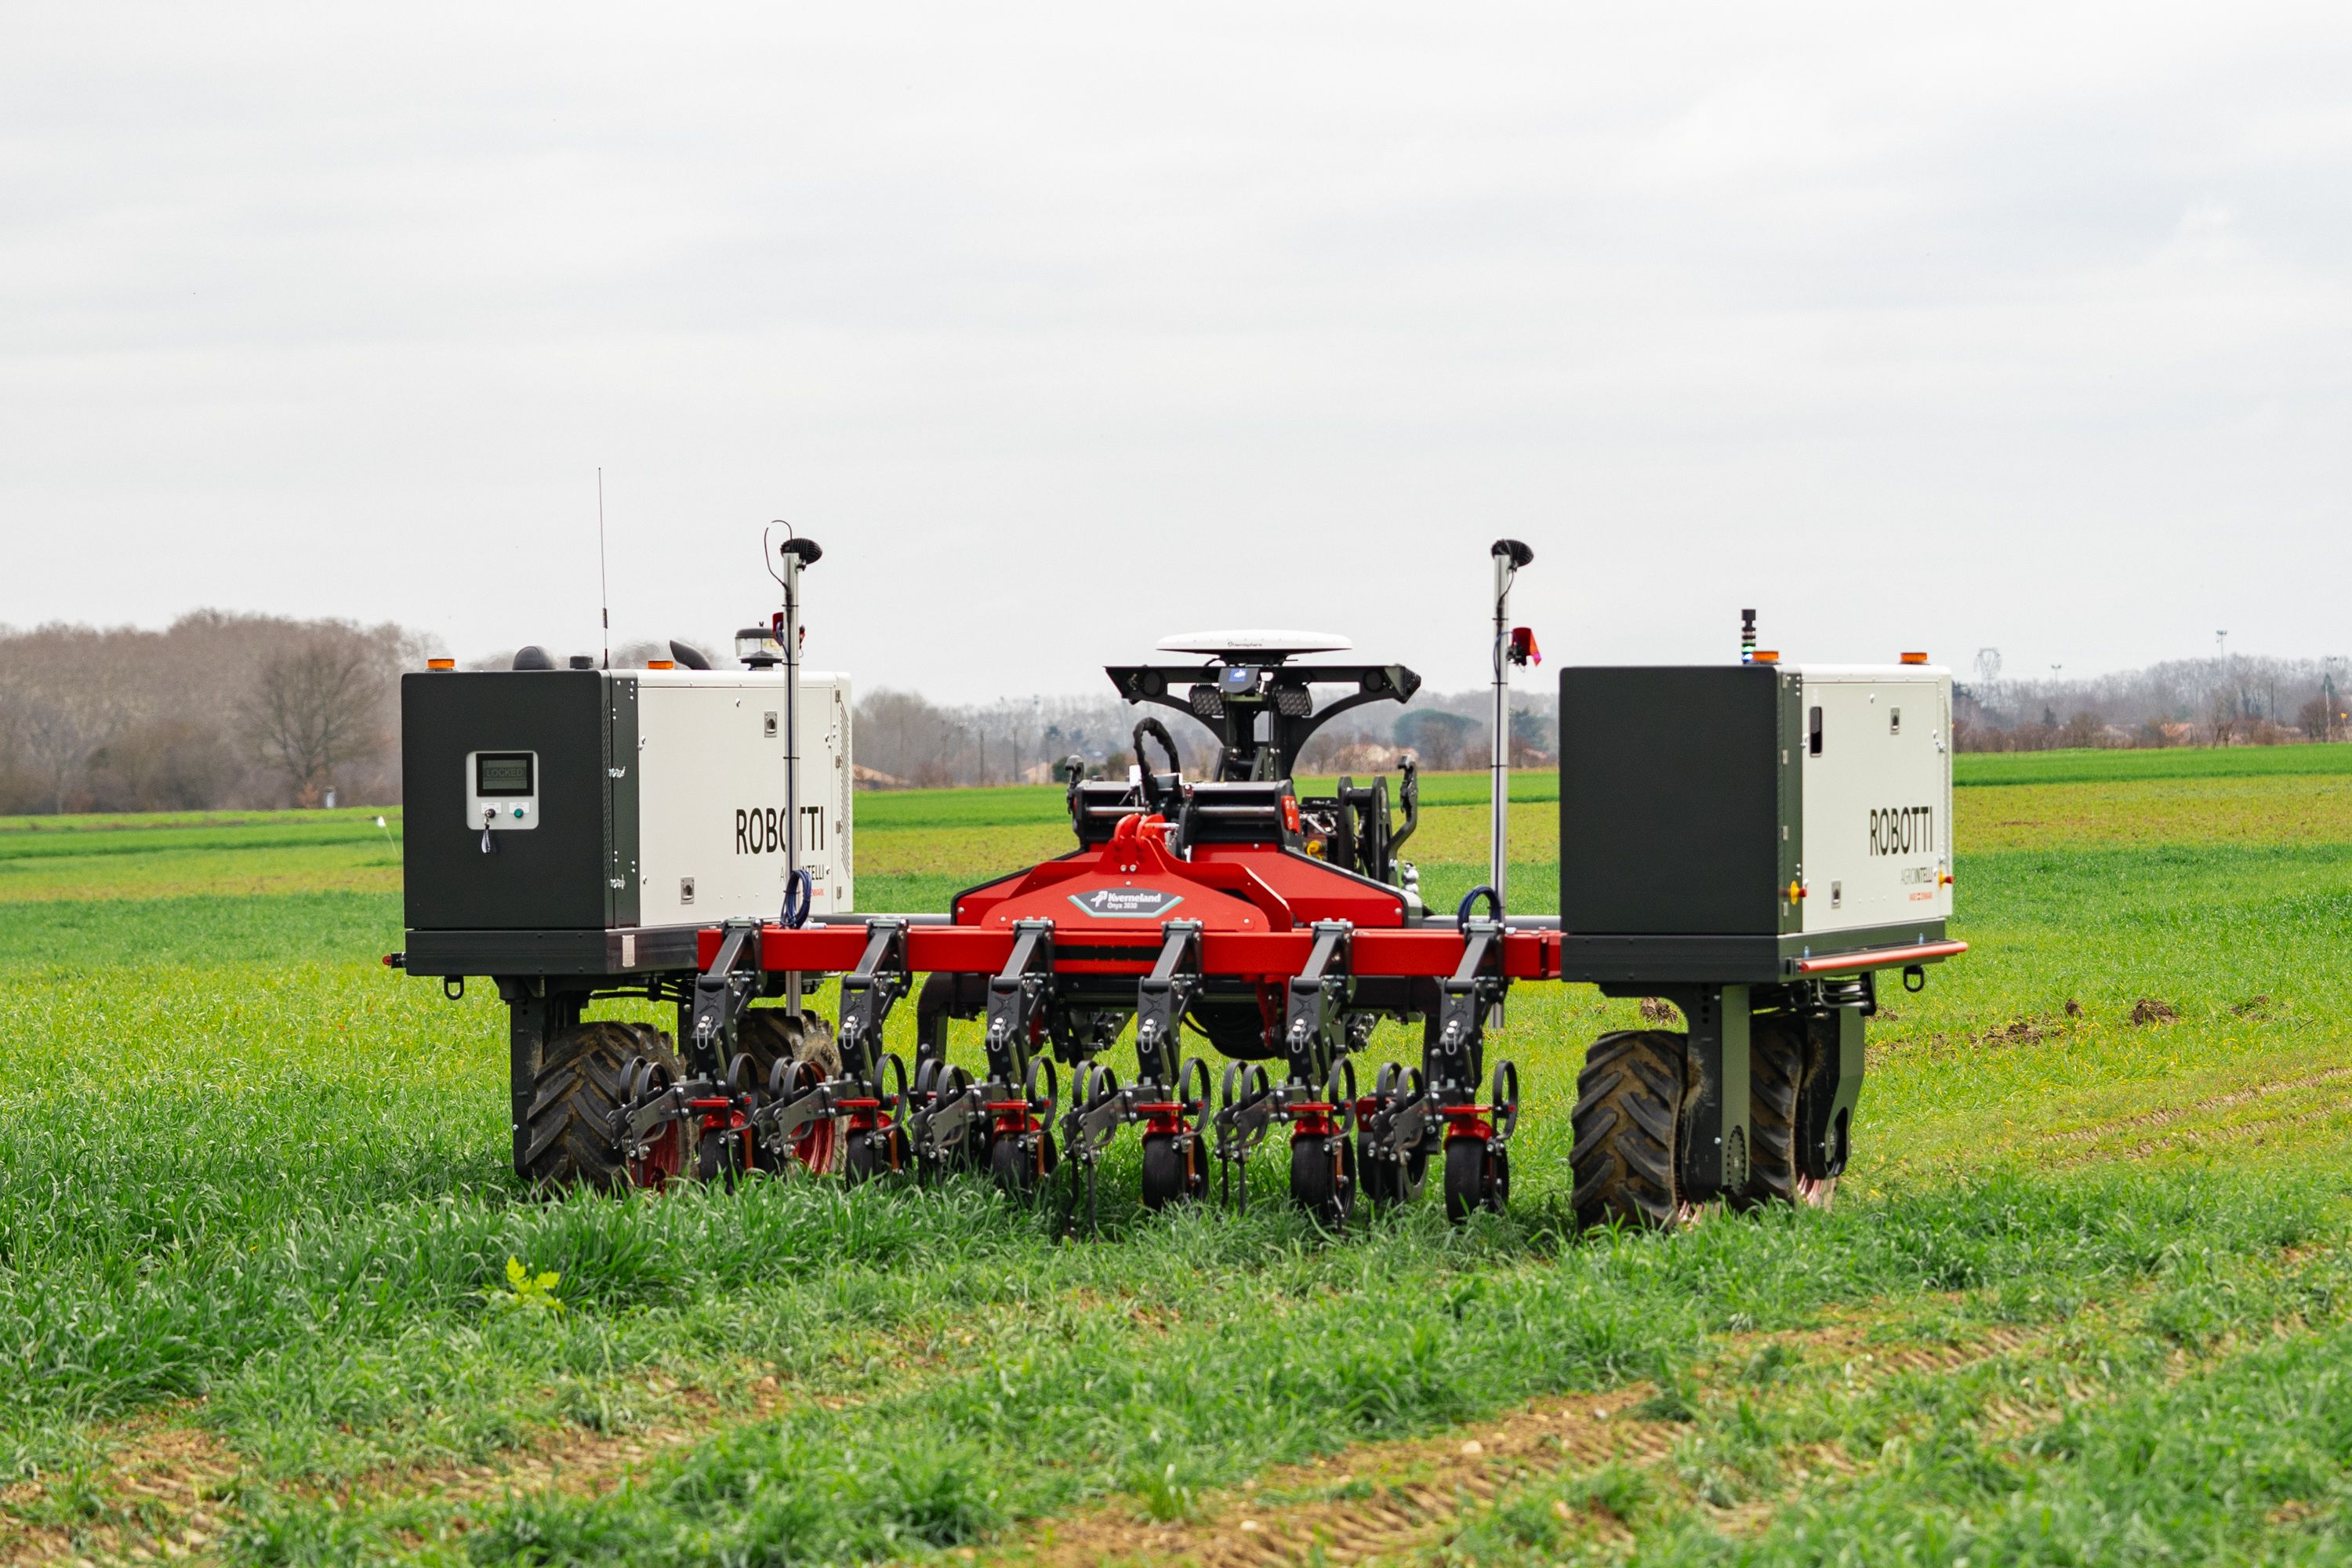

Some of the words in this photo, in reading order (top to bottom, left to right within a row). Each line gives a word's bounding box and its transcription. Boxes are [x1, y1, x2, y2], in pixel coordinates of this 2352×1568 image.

[486, 768, 524, 777] LOCKED
[1870, 806, 1933, 856] ROBOTTI
[1108, 893, 1162, 902] Kverneland
